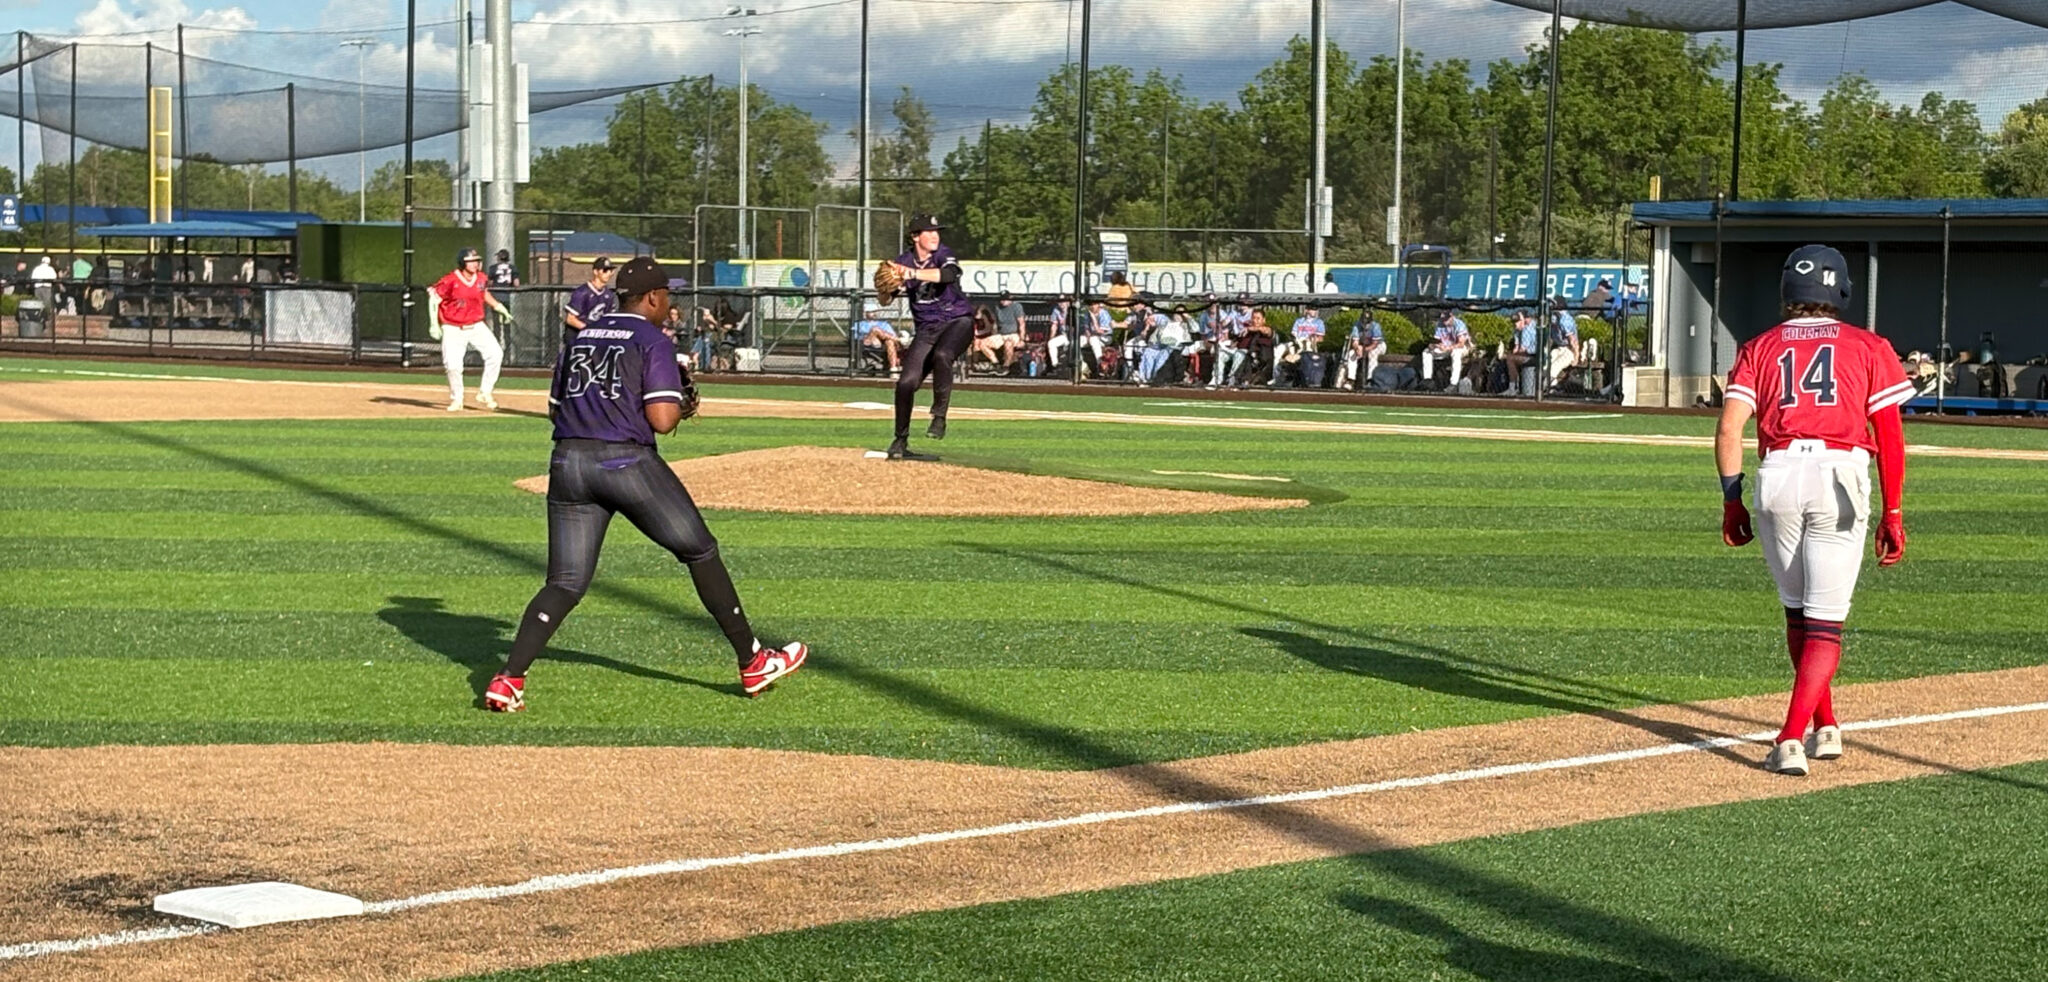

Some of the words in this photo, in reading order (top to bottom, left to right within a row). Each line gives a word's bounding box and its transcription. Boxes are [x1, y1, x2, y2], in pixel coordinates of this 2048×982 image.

[1059, 271, 1314, 294] ORHOPAEDIC
[1385, 274, 1450, 298] LVE
[1467, 274, 1529, 299] LIFE
[1545, 274, 1649, 298] BETTR
[1823, 270, 1836, 286] 14
[1782, 327, 1840, 341] COLEMAN
[565, 345, 625, 399] 34
[1777, 344, 1837, 408] 14
